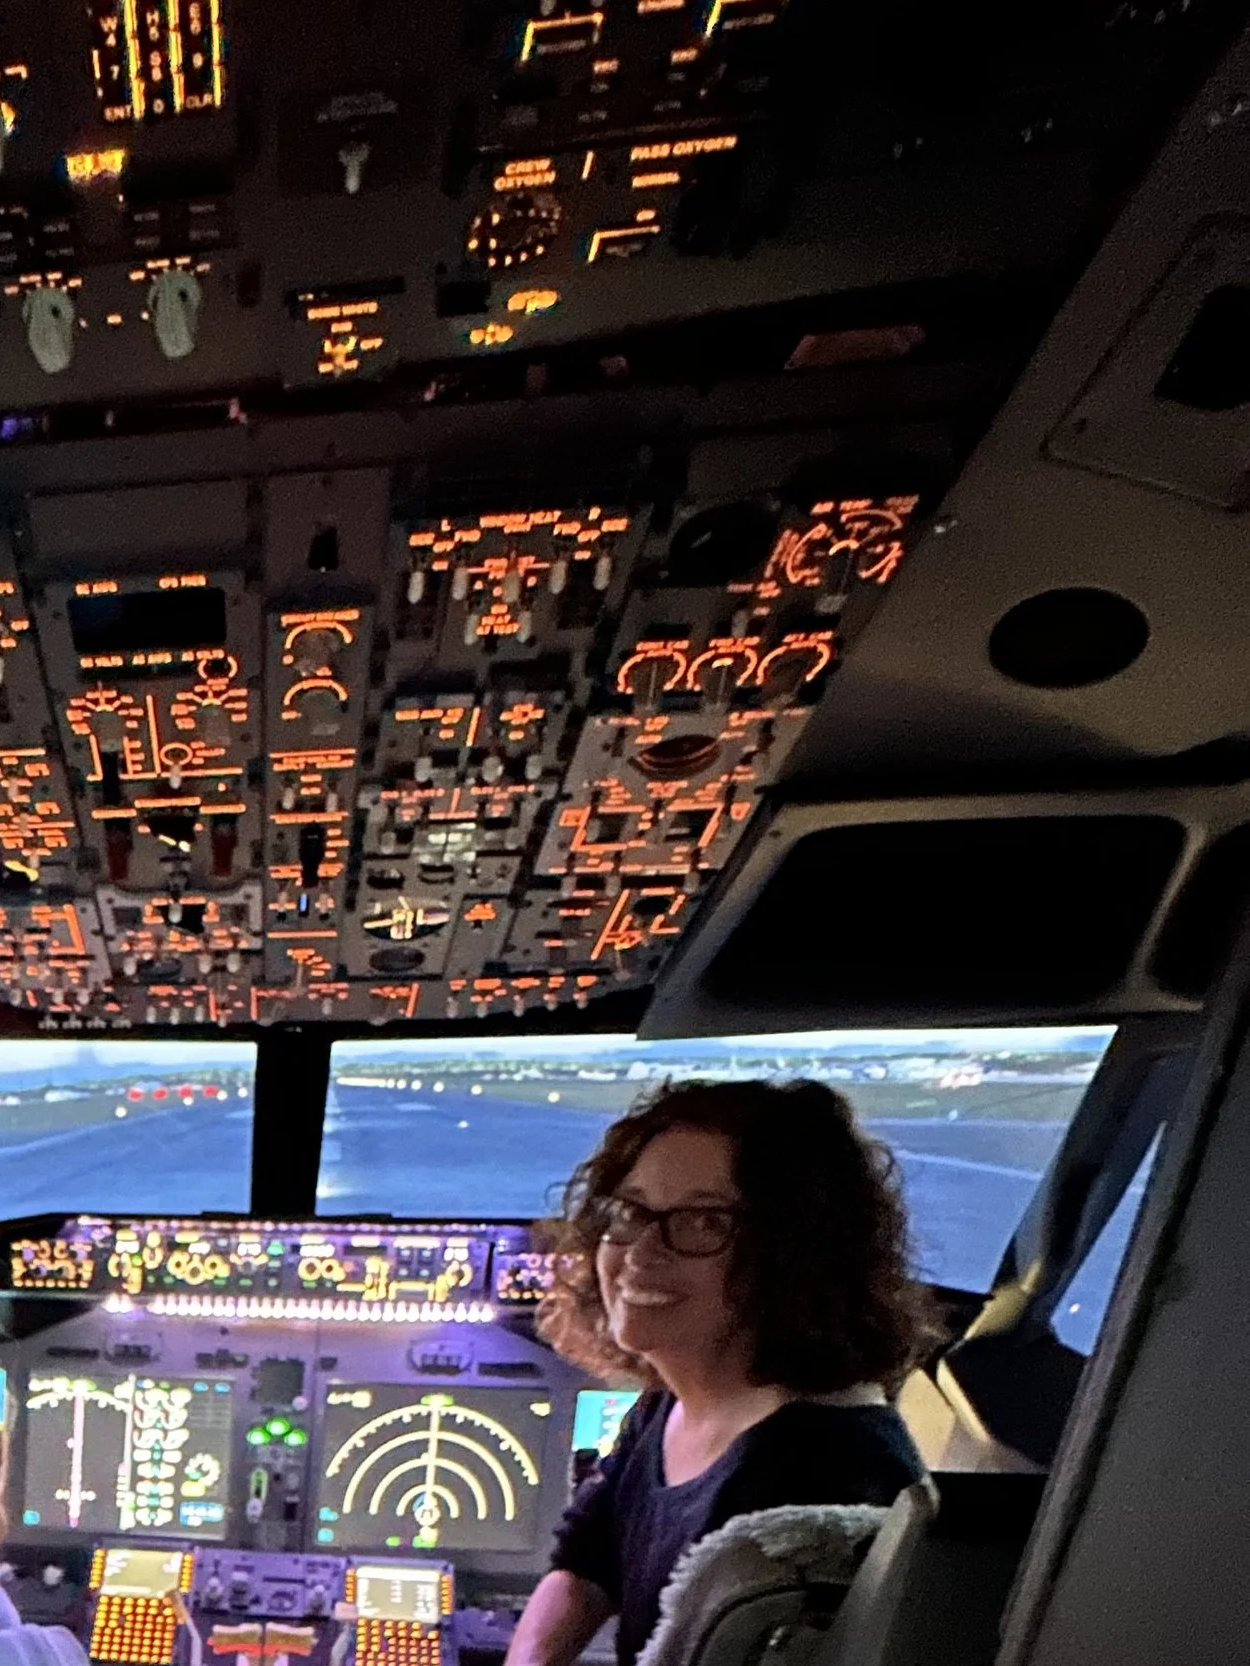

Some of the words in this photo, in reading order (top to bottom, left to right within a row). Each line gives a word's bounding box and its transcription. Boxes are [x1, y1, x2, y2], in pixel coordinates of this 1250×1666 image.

[631, 143, 670, 161] PASS
[672, 136, 737, 155] OXYGEN
[505, 158, 550, 175] CREW
[494, 170, 556, 191] OXYGEN
